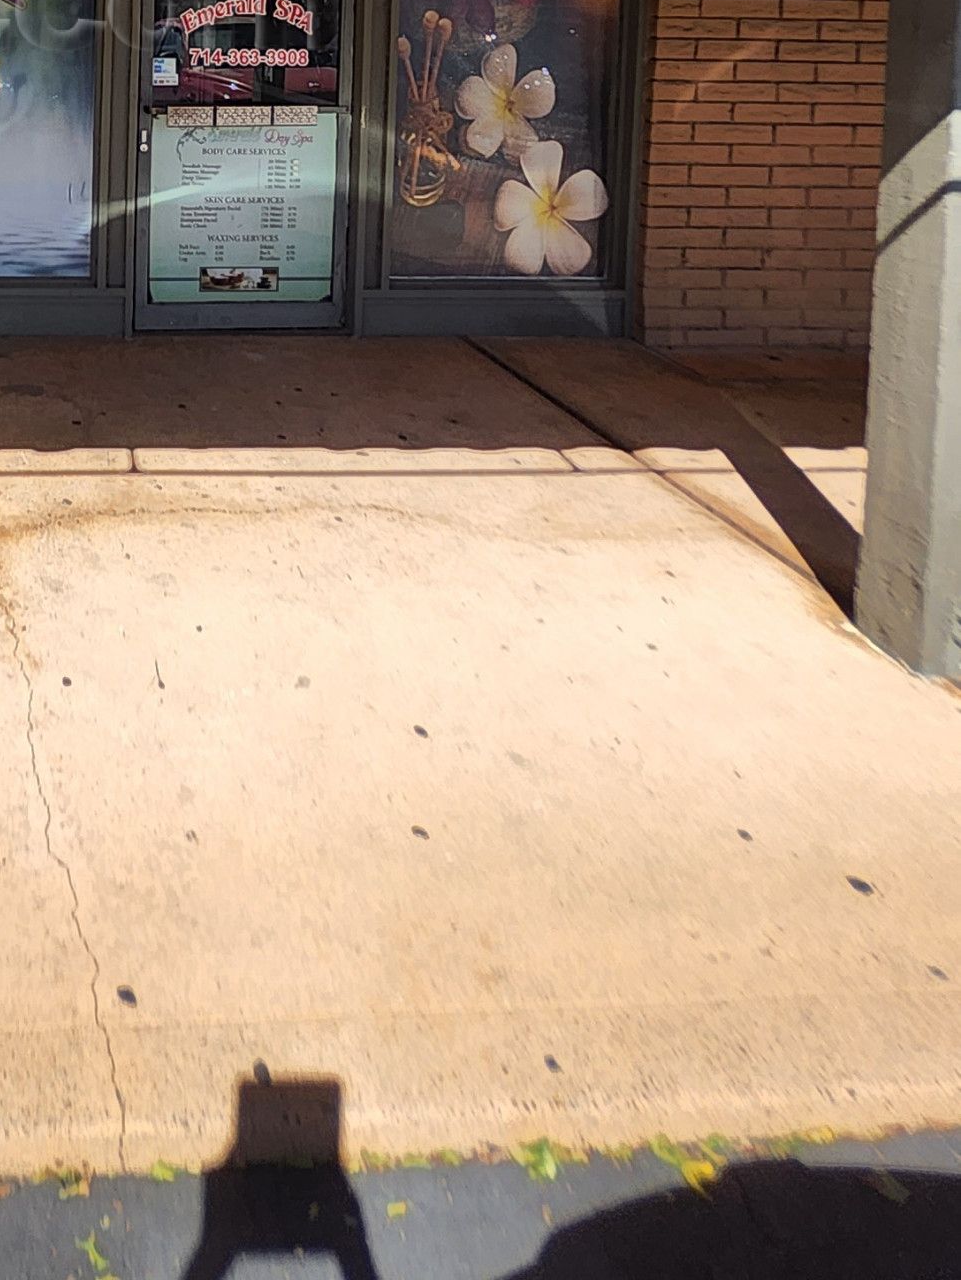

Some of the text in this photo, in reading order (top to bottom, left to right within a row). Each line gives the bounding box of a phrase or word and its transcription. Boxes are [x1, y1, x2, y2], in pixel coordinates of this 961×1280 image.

[189, 48, 310, 67] 714-363-3908
[202, 148, 287, 156] BODY CARE SERVICES
[248, 197, 285, 205] SERVICES
[207, 234, 279, 242] WAXING SERVICES
